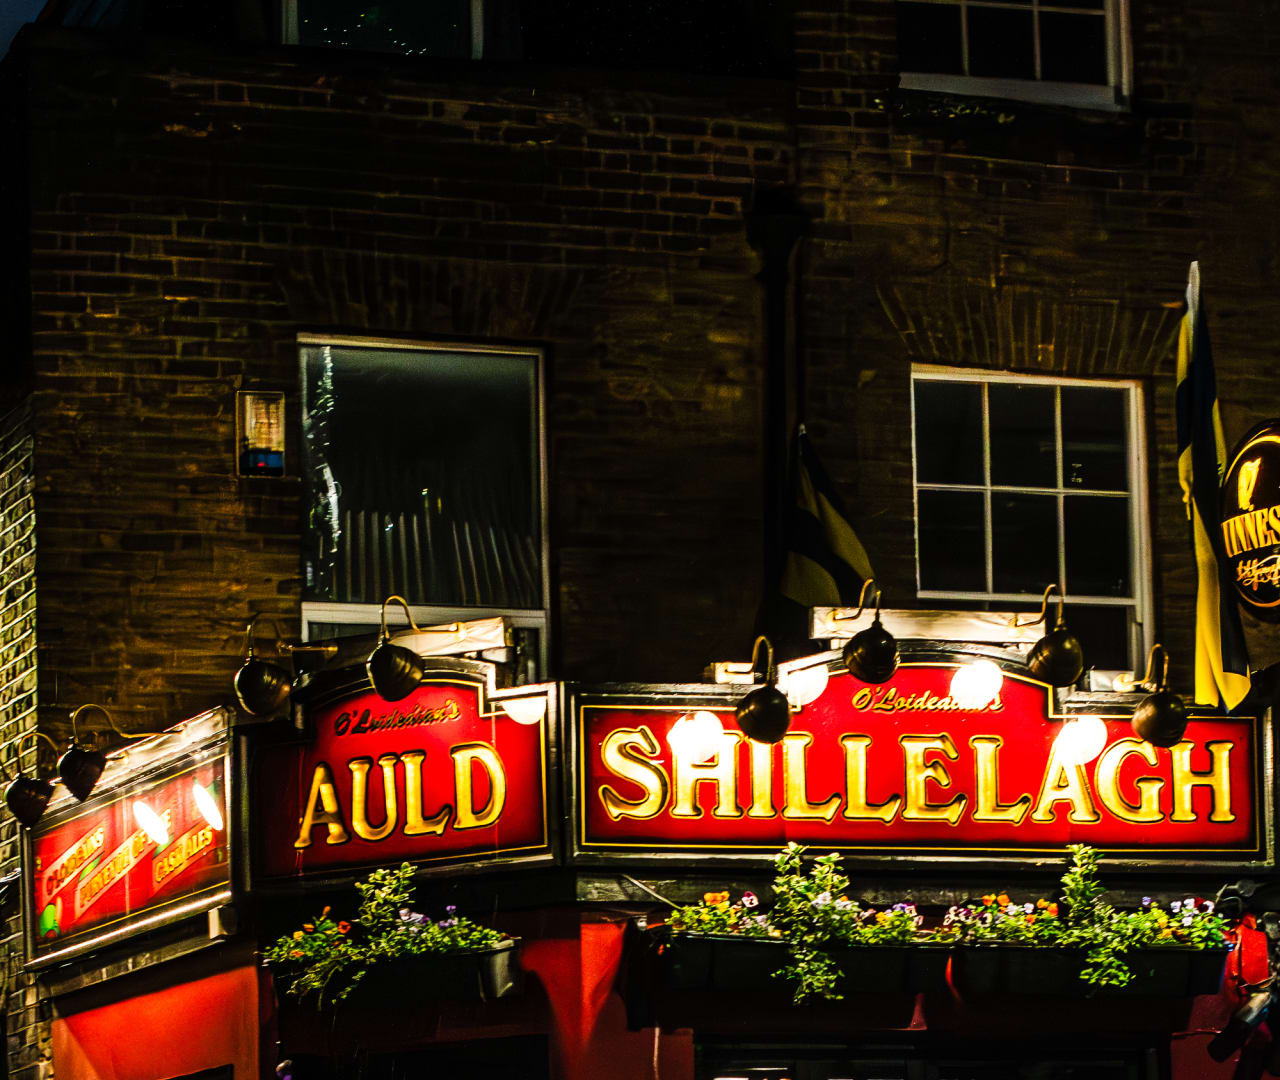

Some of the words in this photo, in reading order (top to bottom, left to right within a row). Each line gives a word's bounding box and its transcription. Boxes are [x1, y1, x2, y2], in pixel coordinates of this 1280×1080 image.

[294, 740, 507, 850] AULD
[598, 726, 1237, 827] SHILLELAGH
[182, 825, 213, 861] ALES
